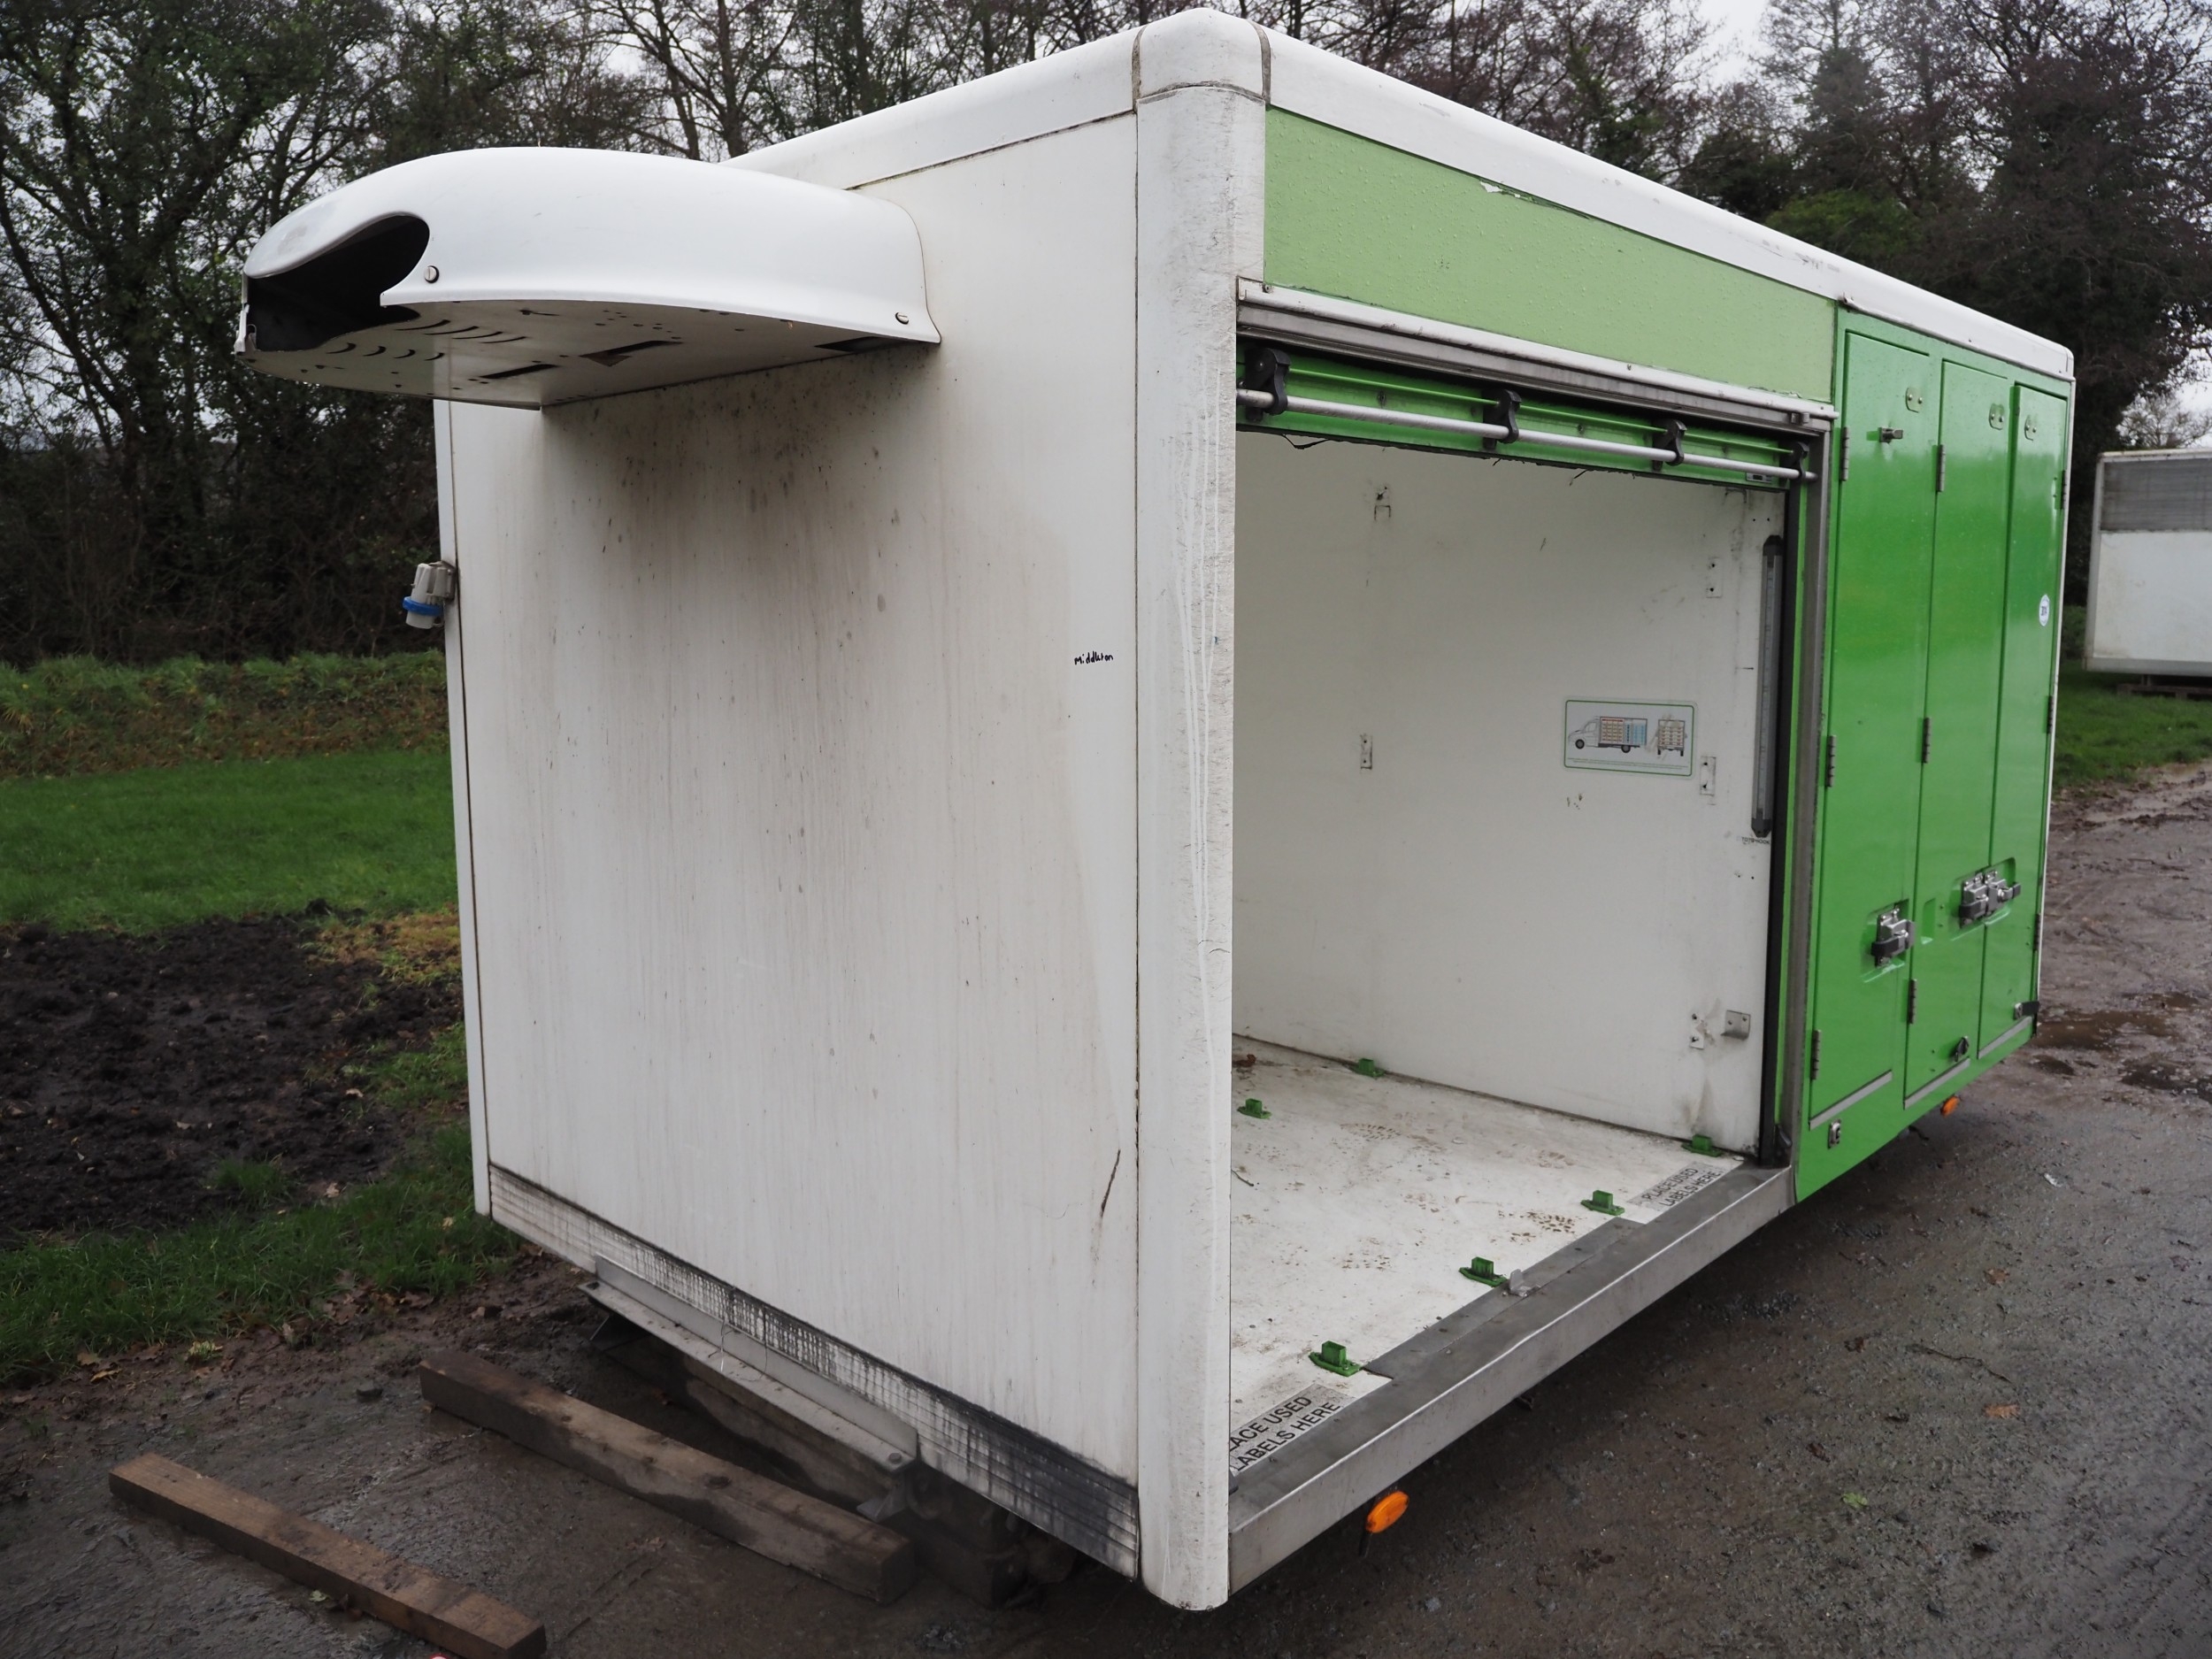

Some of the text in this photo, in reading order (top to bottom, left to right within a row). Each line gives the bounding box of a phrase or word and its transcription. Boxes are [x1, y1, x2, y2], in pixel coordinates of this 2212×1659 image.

[1641, 1168, 1698, 1200] PLACE USED
[1658, 1171, 1721, 1206] LABELS HERE
[1263, 1397, 1311, 1424] USED
[1229, 1402, 1340, 1471] LABELS HERE
